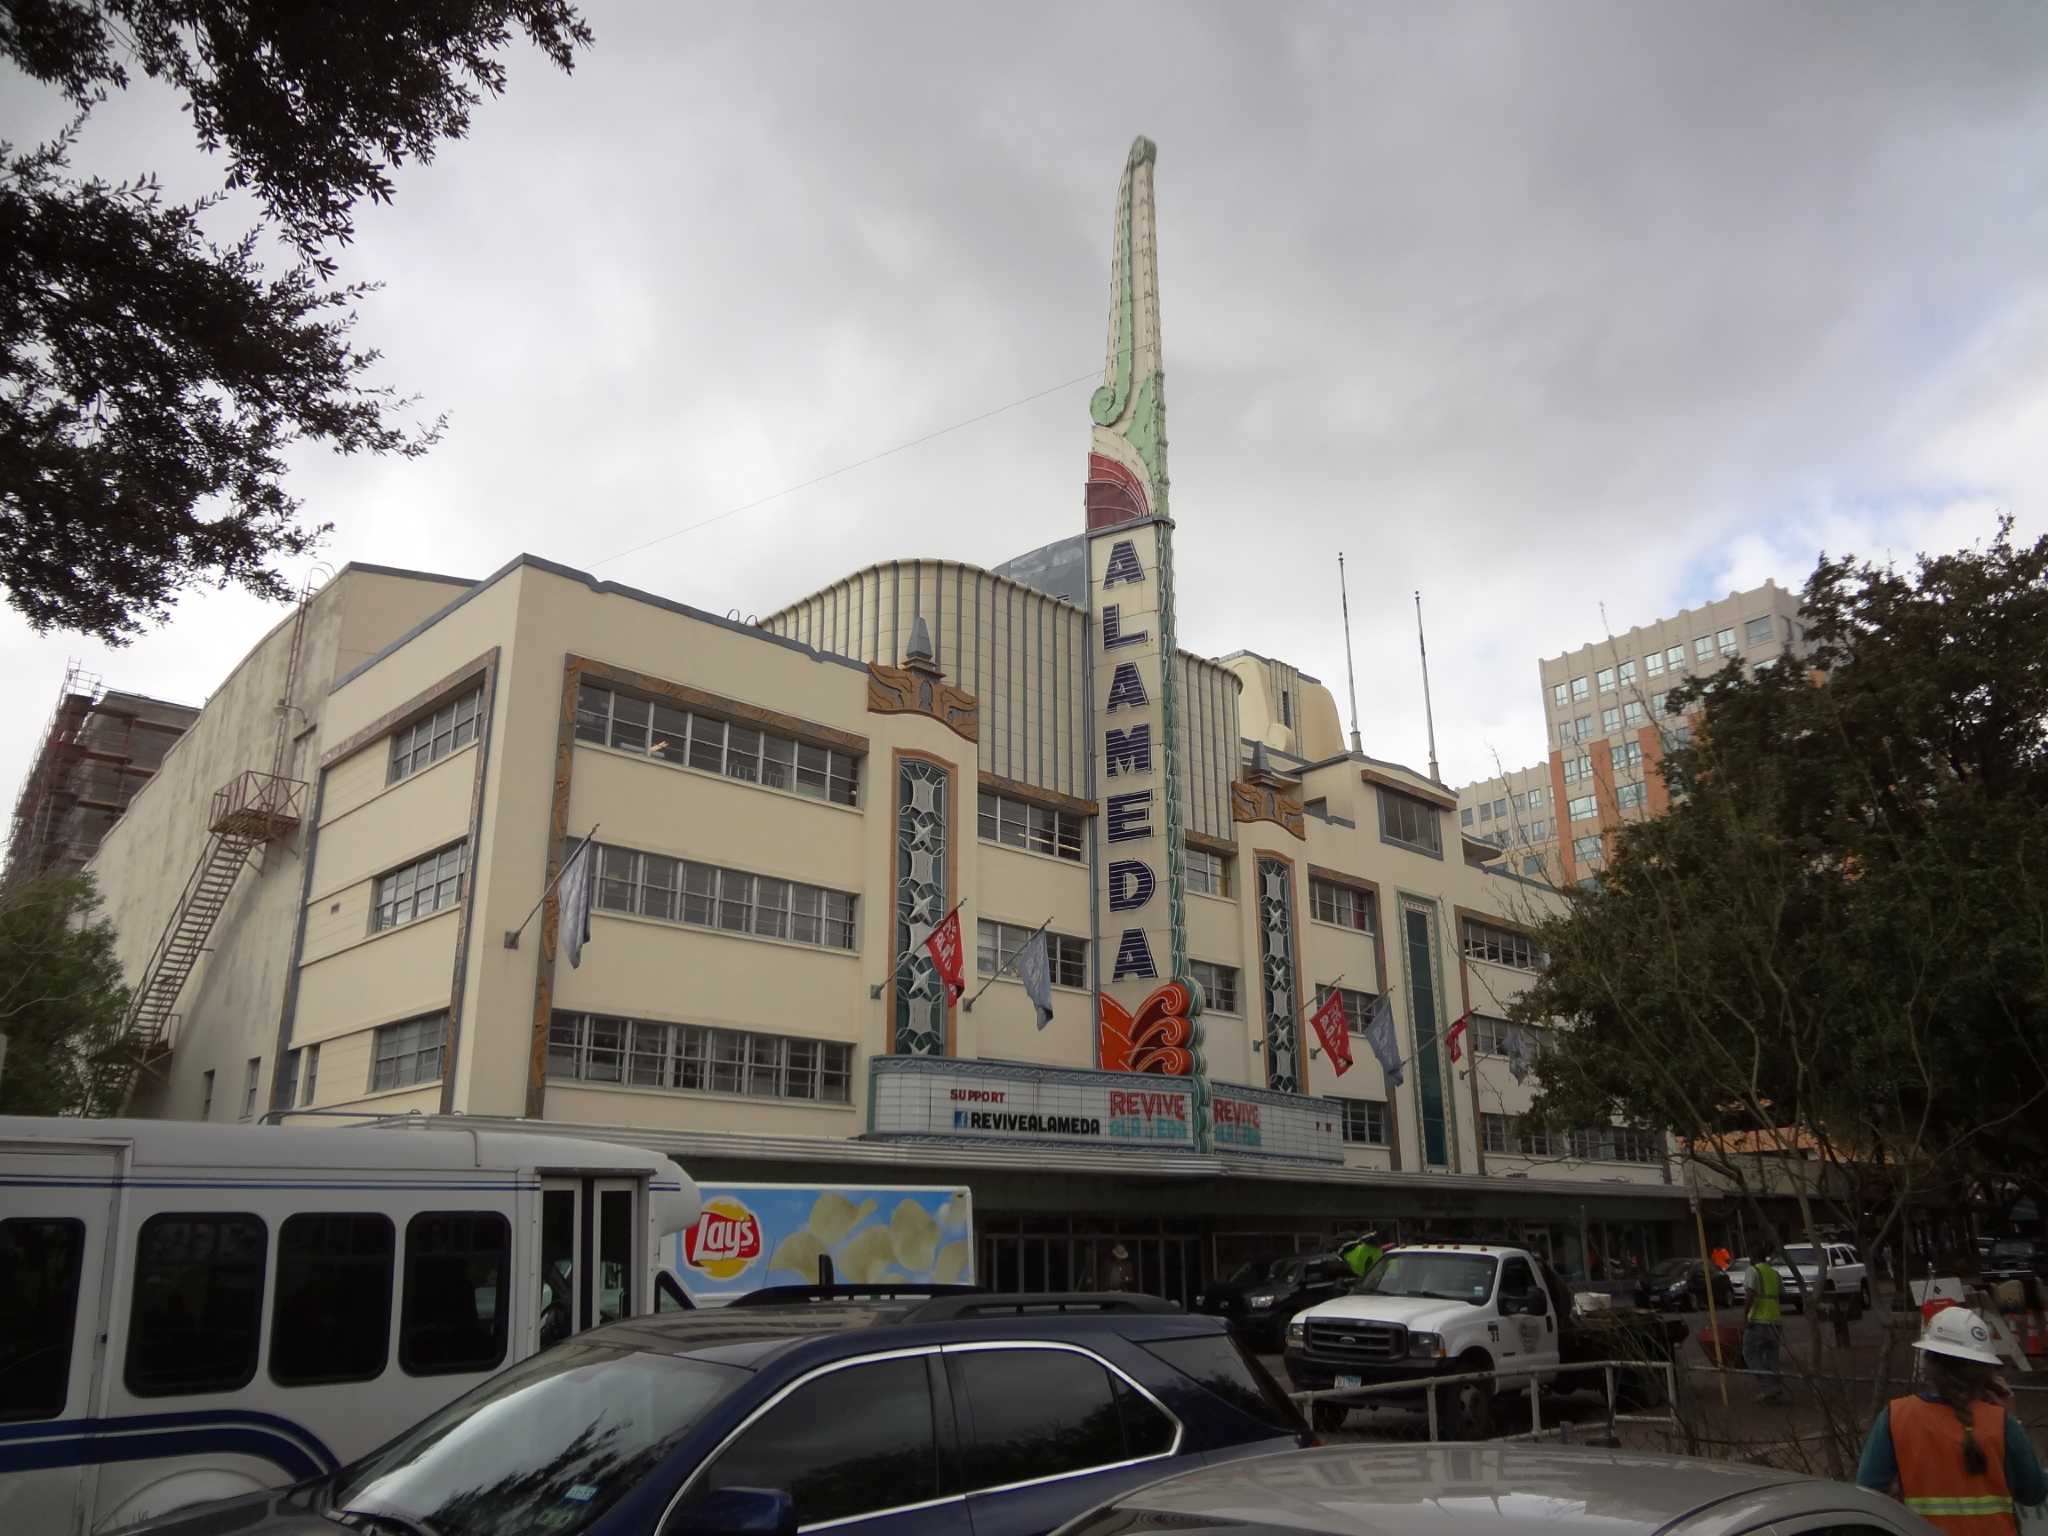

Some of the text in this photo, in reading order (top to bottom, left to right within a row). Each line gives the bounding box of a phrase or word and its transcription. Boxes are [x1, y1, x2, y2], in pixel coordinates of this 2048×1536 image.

[1101, 539, 1158, 984] ALAMEDA
[950, 1088, 1006, 1103] SUPPORT
[1110, 1091, 1186, 1121] REVIVE
[971, 1111, 1100, 1135] REVIVEALAMEDA
[1213, 1099, 1261, 1128] REVIVE
[692, 1214, 754, 1262] Lay's
